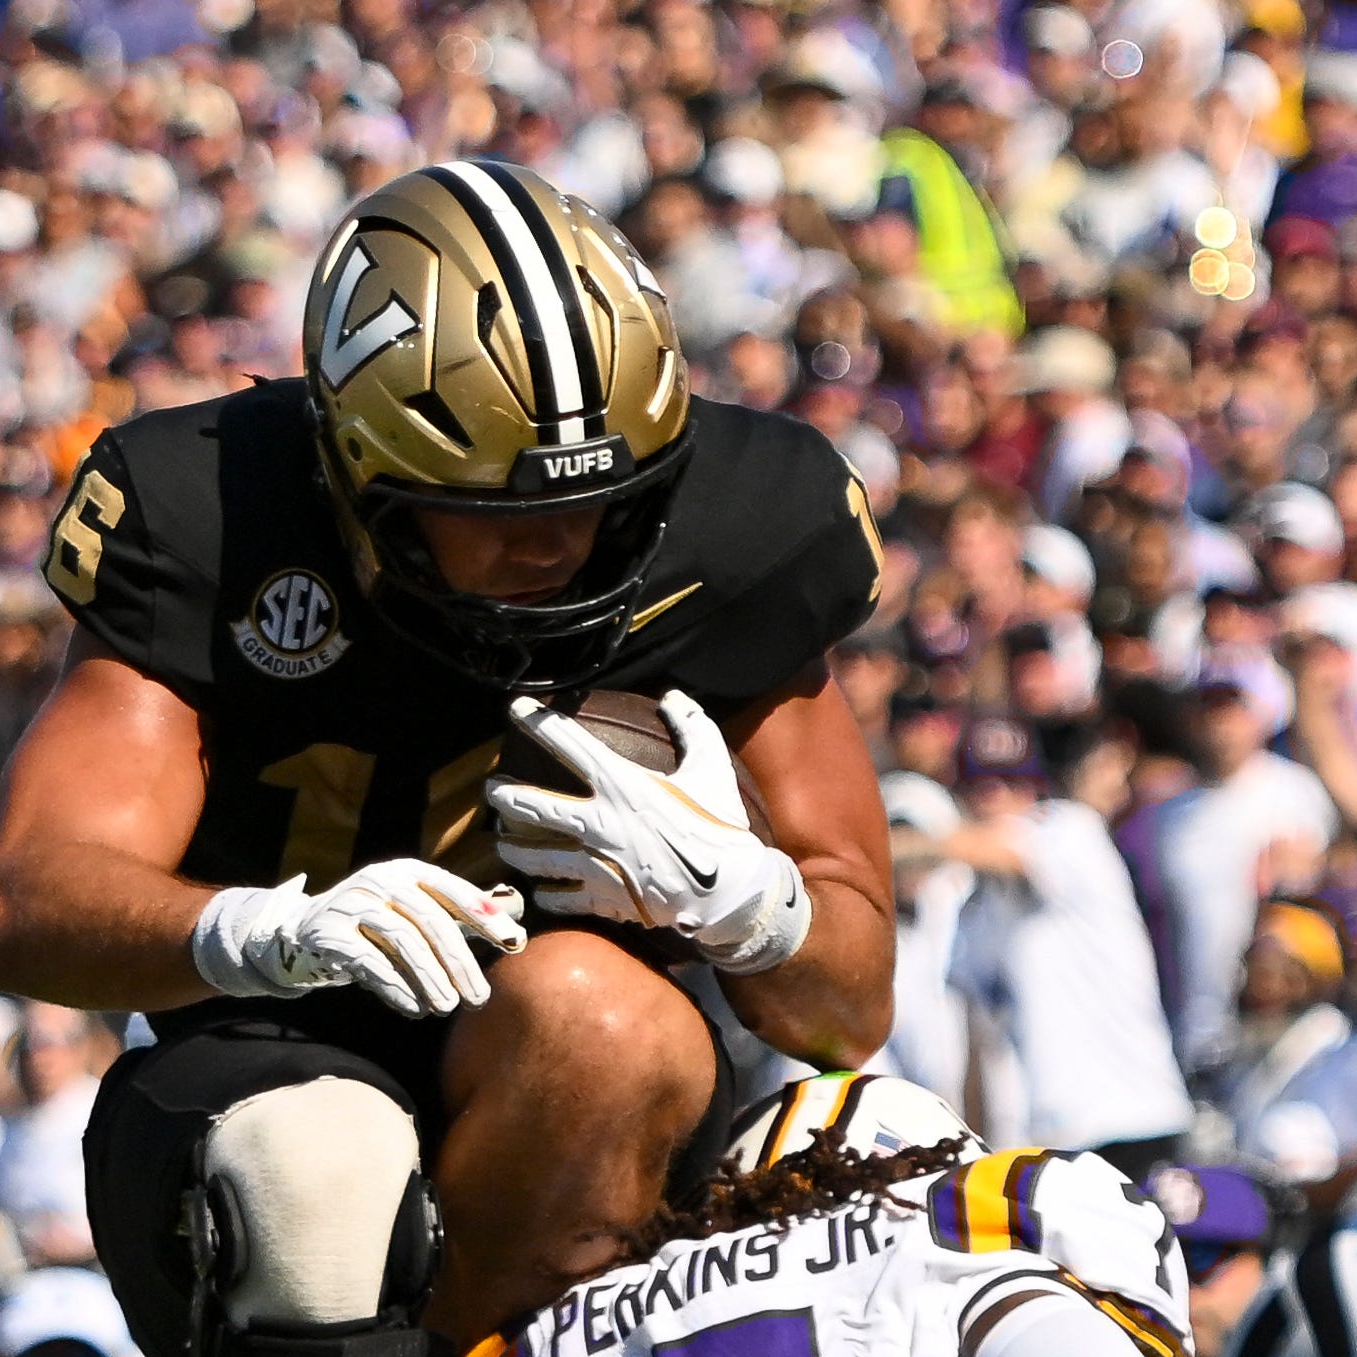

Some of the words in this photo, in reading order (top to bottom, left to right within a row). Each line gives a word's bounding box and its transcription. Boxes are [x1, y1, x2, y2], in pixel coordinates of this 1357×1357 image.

[544, 448, 614, 480] VUFB
[260, 575, 331, 650] SEC
[243, 637, 333, 676] GRADUATE
[806, 1204, 895, 1275] JR.
